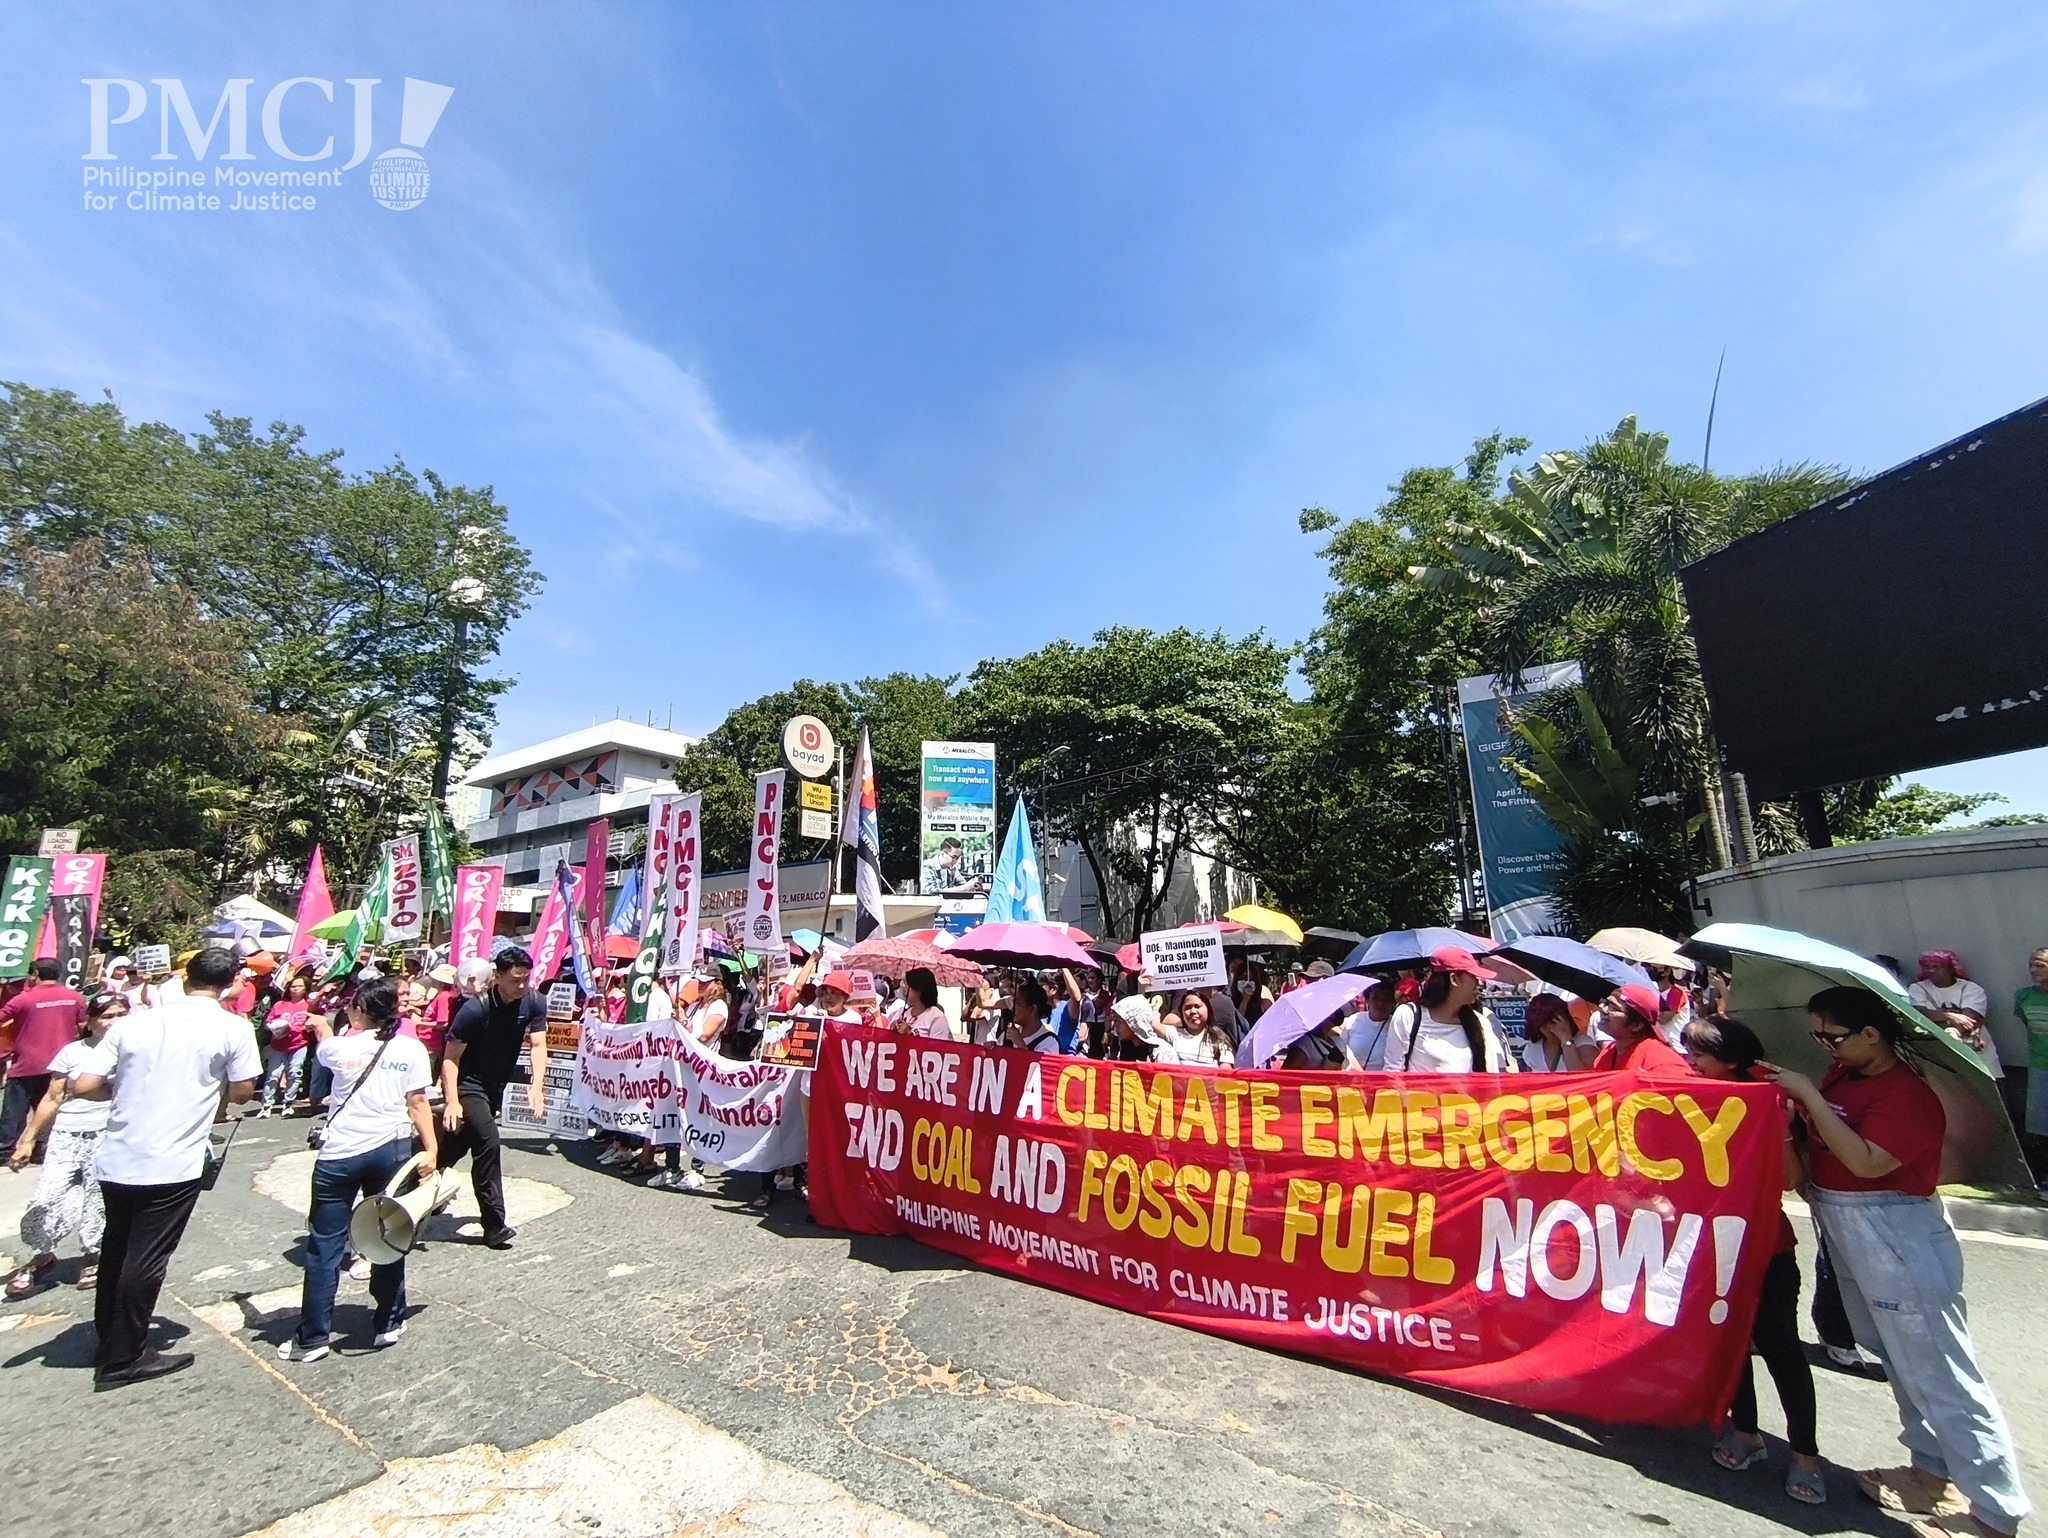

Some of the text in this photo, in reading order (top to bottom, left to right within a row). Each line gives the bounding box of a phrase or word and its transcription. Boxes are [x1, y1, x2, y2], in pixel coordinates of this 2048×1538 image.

[793, 747, 824, 763] bayad
[933, 765, 961, 773] Transact
[962, 765, 976, 774] with
[958, 776, 989, 784] anywhere
[806, 792, 827, 801] Western
[1496, 788, 1516, 797] April
[809, 799, 824, 807] Union
[1491, 800, 1507, 808] The
[1509, 798, 1529, 806] Fifth
[808, 814, 825, 823] bayad
[391, 842, 413, 861] SM
[1498, 856, 1533, 864] Discover
[1498, 866, 1524, 874] Power
[1526, 864, 1542, 872] and
[390, 862, 417, 928] ZOTO
[701, 888, 748, 910] CENTER
[790, 892, 825, 903] MERALCO
[0, 867, 43, 967] K4K QC
[1165, 937, 1216, 951] Manindigan
[1155, 949, 1208, 962] Para sa Mga
[1158, 961, 1207, 974] Konsyumer
[1492, 999, 1527, 1007] Business
[1496, 1007, 1525, 1018] (RBC)
[556, 1079, 571, 1088] FUELS
[841, 1038, 1747, 1187] WE ARE IN A CLIMATE EMERGENCY
[613, 1111, 652, 1126] PEOPLE
[685, 1124, 726, 1153] (P4P)
[845, 1102, 1747, 1328] END COAL AND FOSSIL FUEL NOW!
[988, 1221, 1100, 1276] MOVEMENT
[1110, 1255, 1159, 1292] FOR
[1169, 1269, 1289, 1321] CLIMATE
